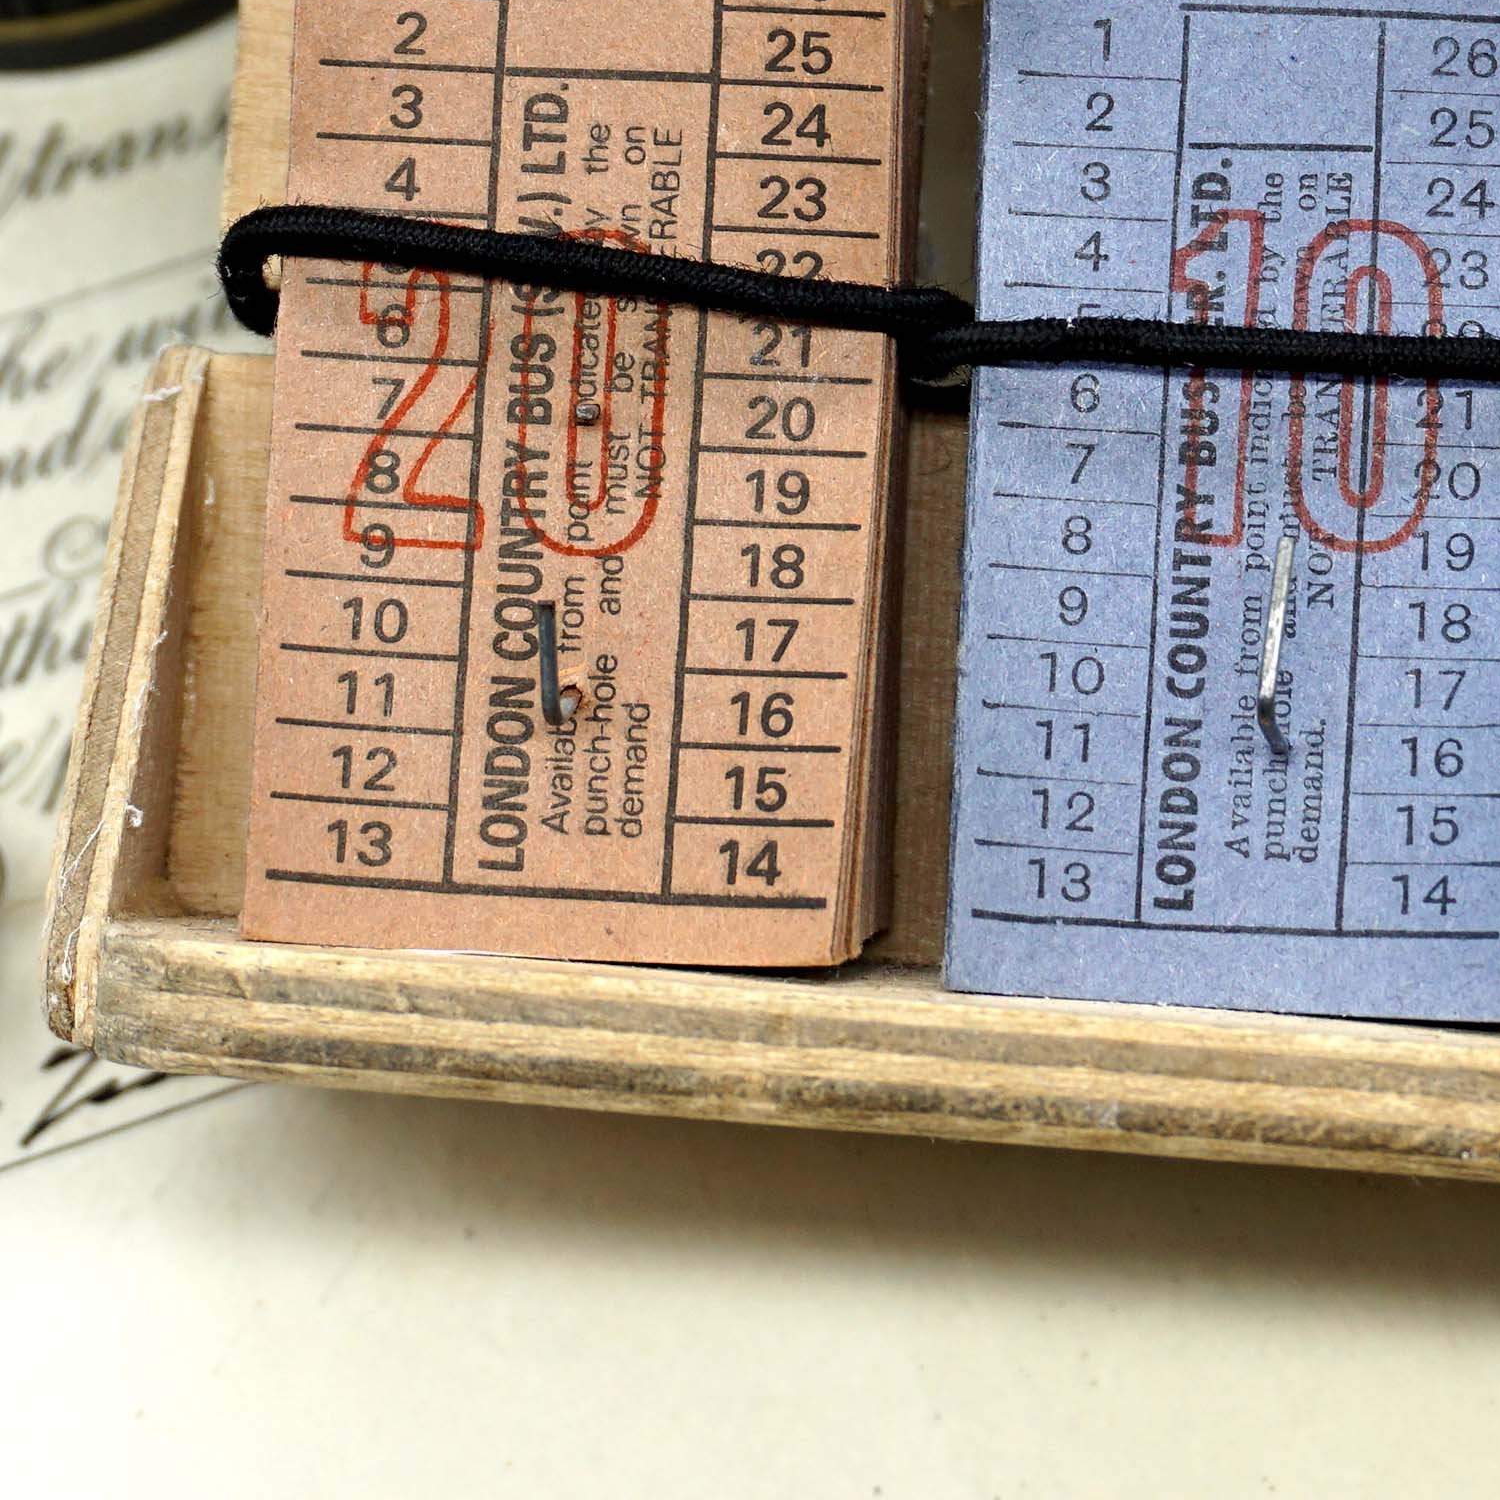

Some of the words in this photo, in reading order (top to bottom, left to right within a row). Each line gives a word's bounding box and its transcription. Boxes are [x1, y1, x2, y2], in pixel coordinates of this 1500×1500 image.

[394, 11, 427, 55] 2
[765, 27, 832, 75] 25
[1094, 18, 1111, 61] 1
[1432, 36, 1498, 78] 26
[521, 83, 569, 174] LTD.
[761, 101, 831, 148] 24
[1085, 92, 1114, 131] 2
[1429, 107, 1494, 149] 25
[581, 122, 611, 175] the
[623, 126, 646, 165] on
[1190, 158, 1232, 250] LTD.
[1259, 173, 1284, 223] the
[1299, 174, 1318, 212] on
[1426, 178, 1495, 220] 24
[514, 331, 556, 425] BUS
[616, 350, 636, 394] be
[1176, 379, 1221, 468] BUS
[607, 432, 629, 514] must
[636, 429, 666, 499] NOT
[569, 459, 593, 540] point
[1246, 481, 1272, 571] point
[493, 439, 551, 662] COUNTRY
[603, 554, 625, 615] and
[1167, 481, 1215, 699] COUNTRY
[560, 575, 586, 653] from
[1240, 594, 1264, 681] from
[582, 654, 618, 836] punch-hole
[478, 676, 536, 871] LONDON
[725, 766, 787, 812] 15
[1225, 693, 1257, 857] Available
[1292, 719, 1326, 863] demand.
[1153, 717, 1203, 911] LONDON
[1397, 805, 1459, 846] 15
[328, 819, 392, 867] 13
[720, 839, 781, 886] 14
[1028, 858, 1090, 902] 13
[1392, 875, 1456, 915] 14
